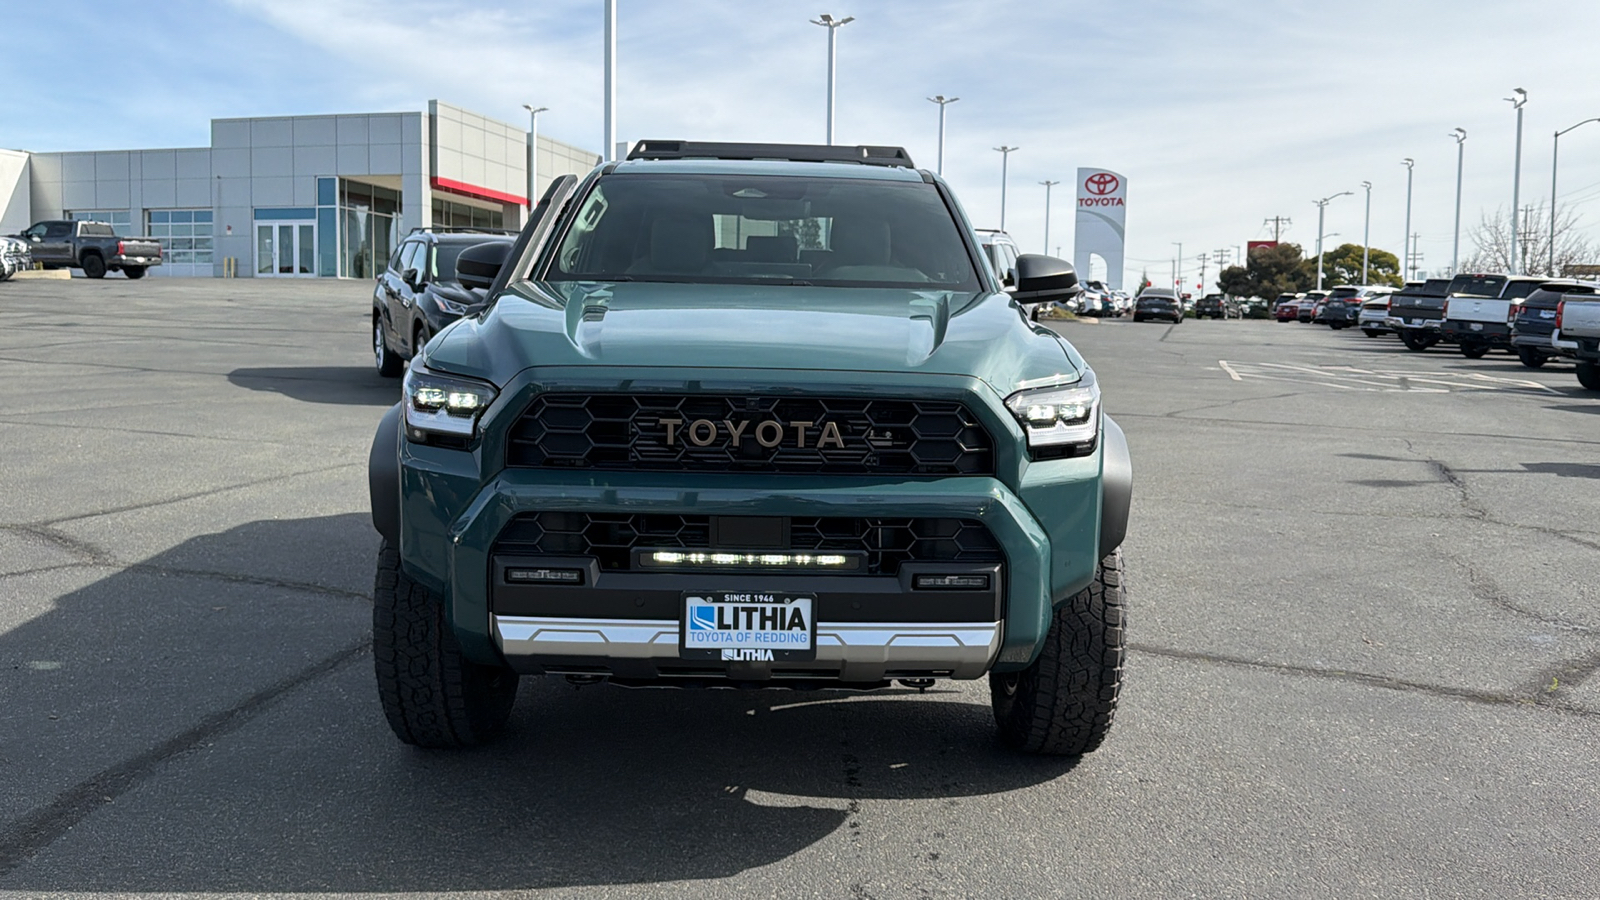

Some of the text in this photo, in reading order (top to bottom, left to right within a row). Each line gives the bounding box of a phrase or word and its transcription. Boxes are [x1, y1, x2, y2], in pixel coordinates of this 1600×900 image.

[1079, 197, 1124, 207] TOYOTA
[659, 418, 845, 449] TOYOTA
[724, 594, 774, 603] SINCE 1946
[717, 606, 807, 631] LITHIA
[690, 631, 808, 644] TOYOTA OF REDDING
[732, 649, 775, 662] LITHIA
